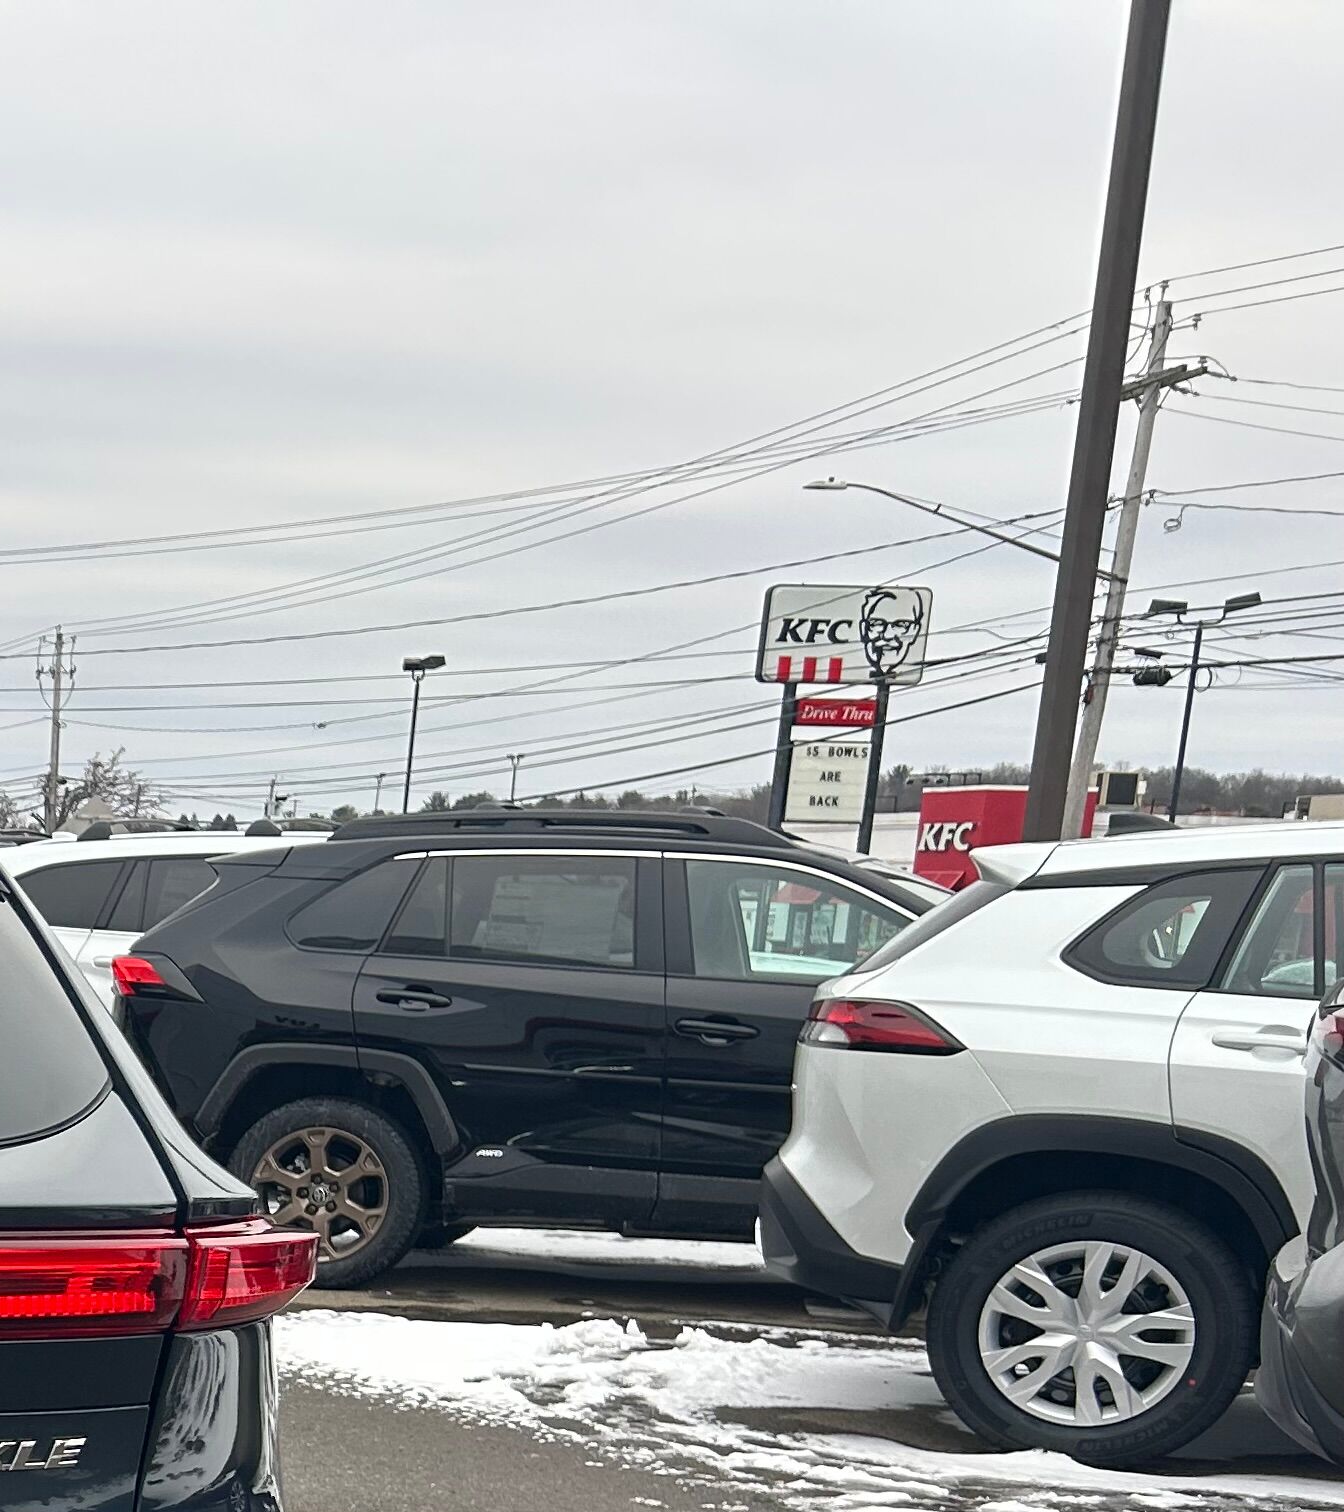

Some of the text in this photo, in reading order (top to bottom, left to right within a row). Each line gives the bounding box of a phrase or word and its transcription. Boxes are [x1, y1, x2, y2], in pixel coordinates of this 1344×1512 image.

[775, 618, 853, 644] KFC
[801, 705, 874, 720] Drive Thru
[828, 746, 869, 758] BOWLS
[819, 771, 842, 782] ARE
[809, 796, 839, 807] BACK
[917, 822, 974, 852] KFC
